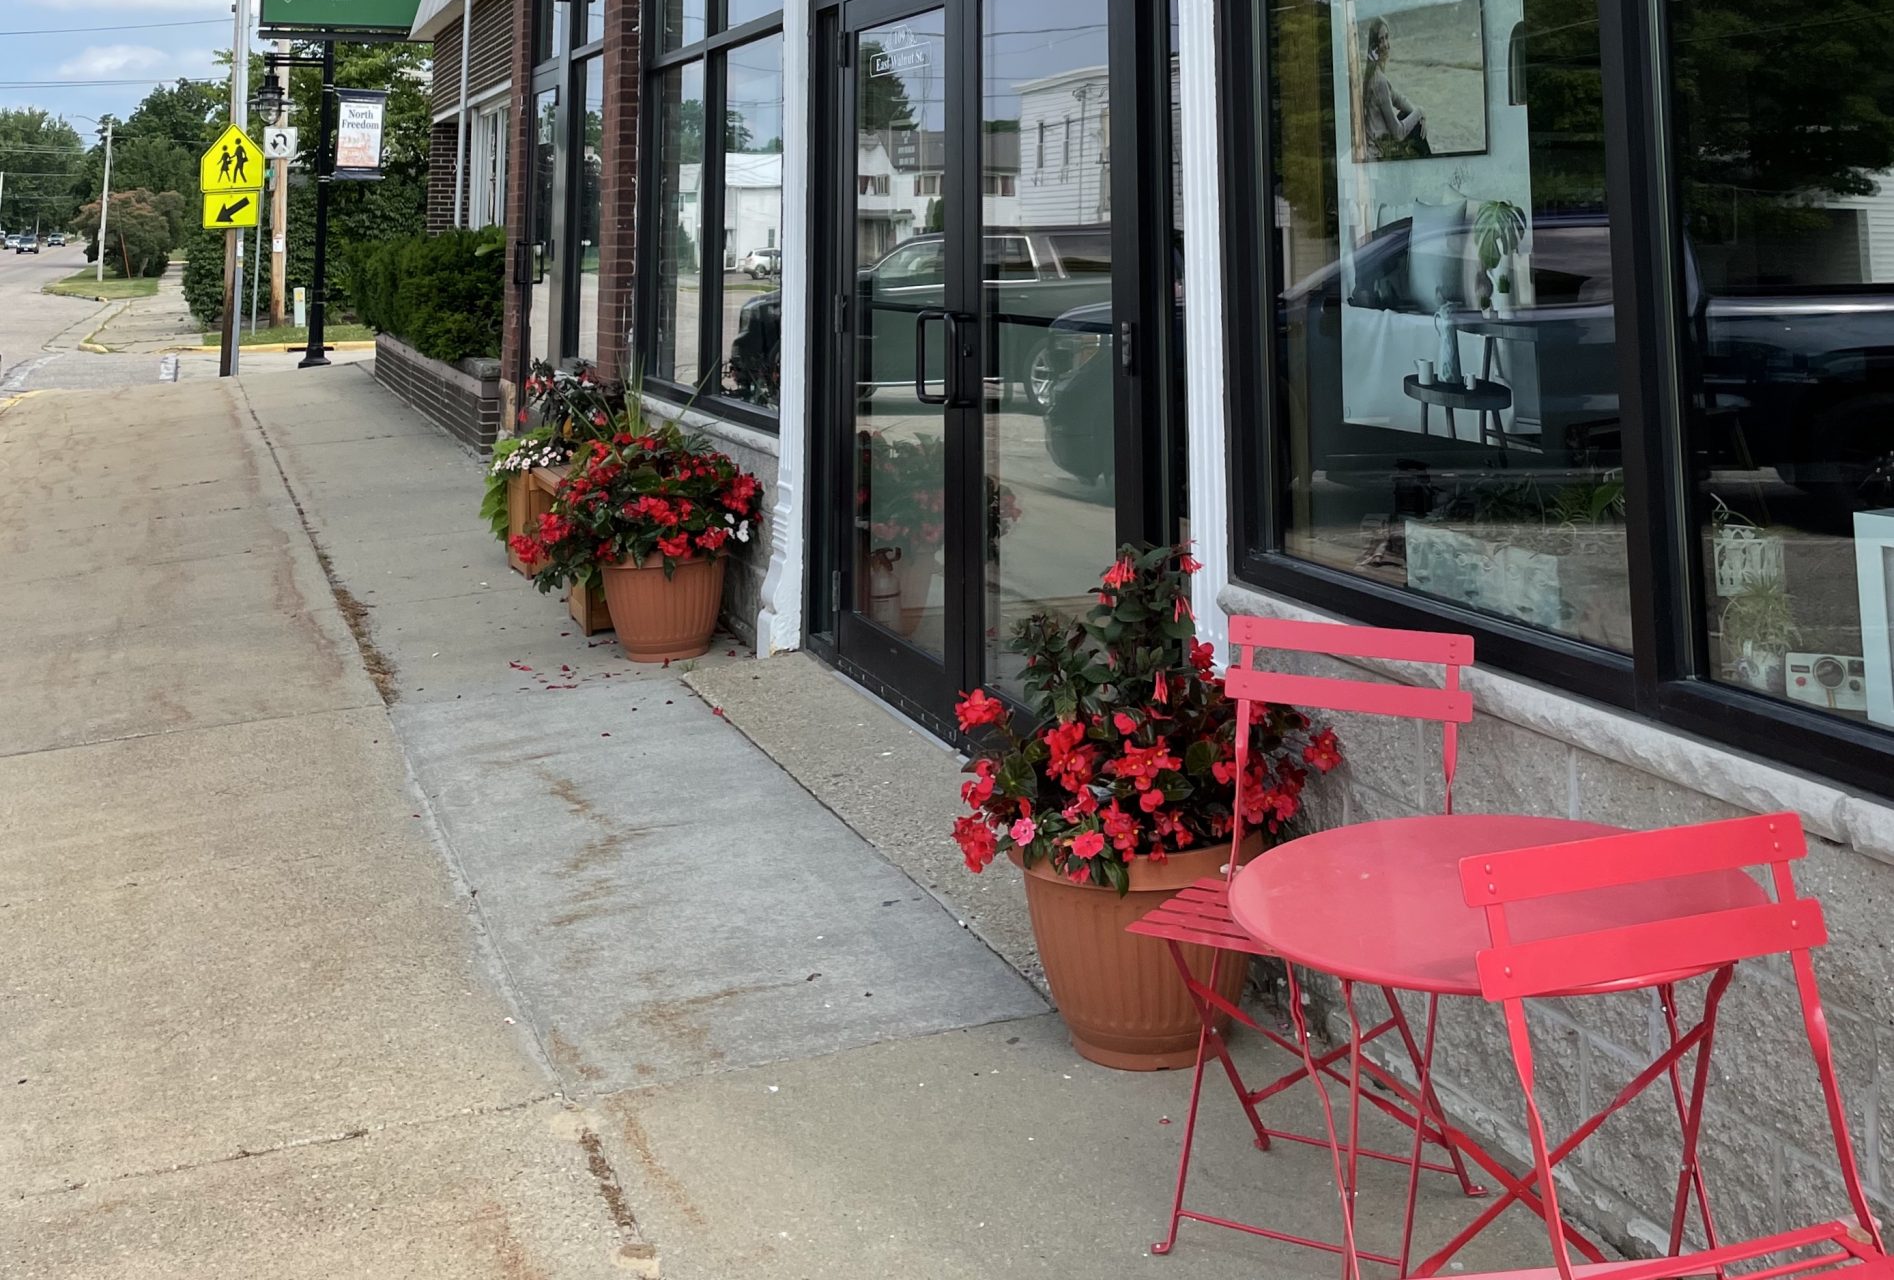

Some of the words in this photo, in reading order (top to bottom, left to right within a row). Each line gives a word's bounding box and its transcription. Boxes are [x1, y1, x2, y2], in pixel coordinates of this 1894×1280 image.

[876, 58, 890, 72] East
[891, 52, 914, 69] Walnut
[348, 109, 374, 119] North
[341, 119, 379, 129] Freedom
